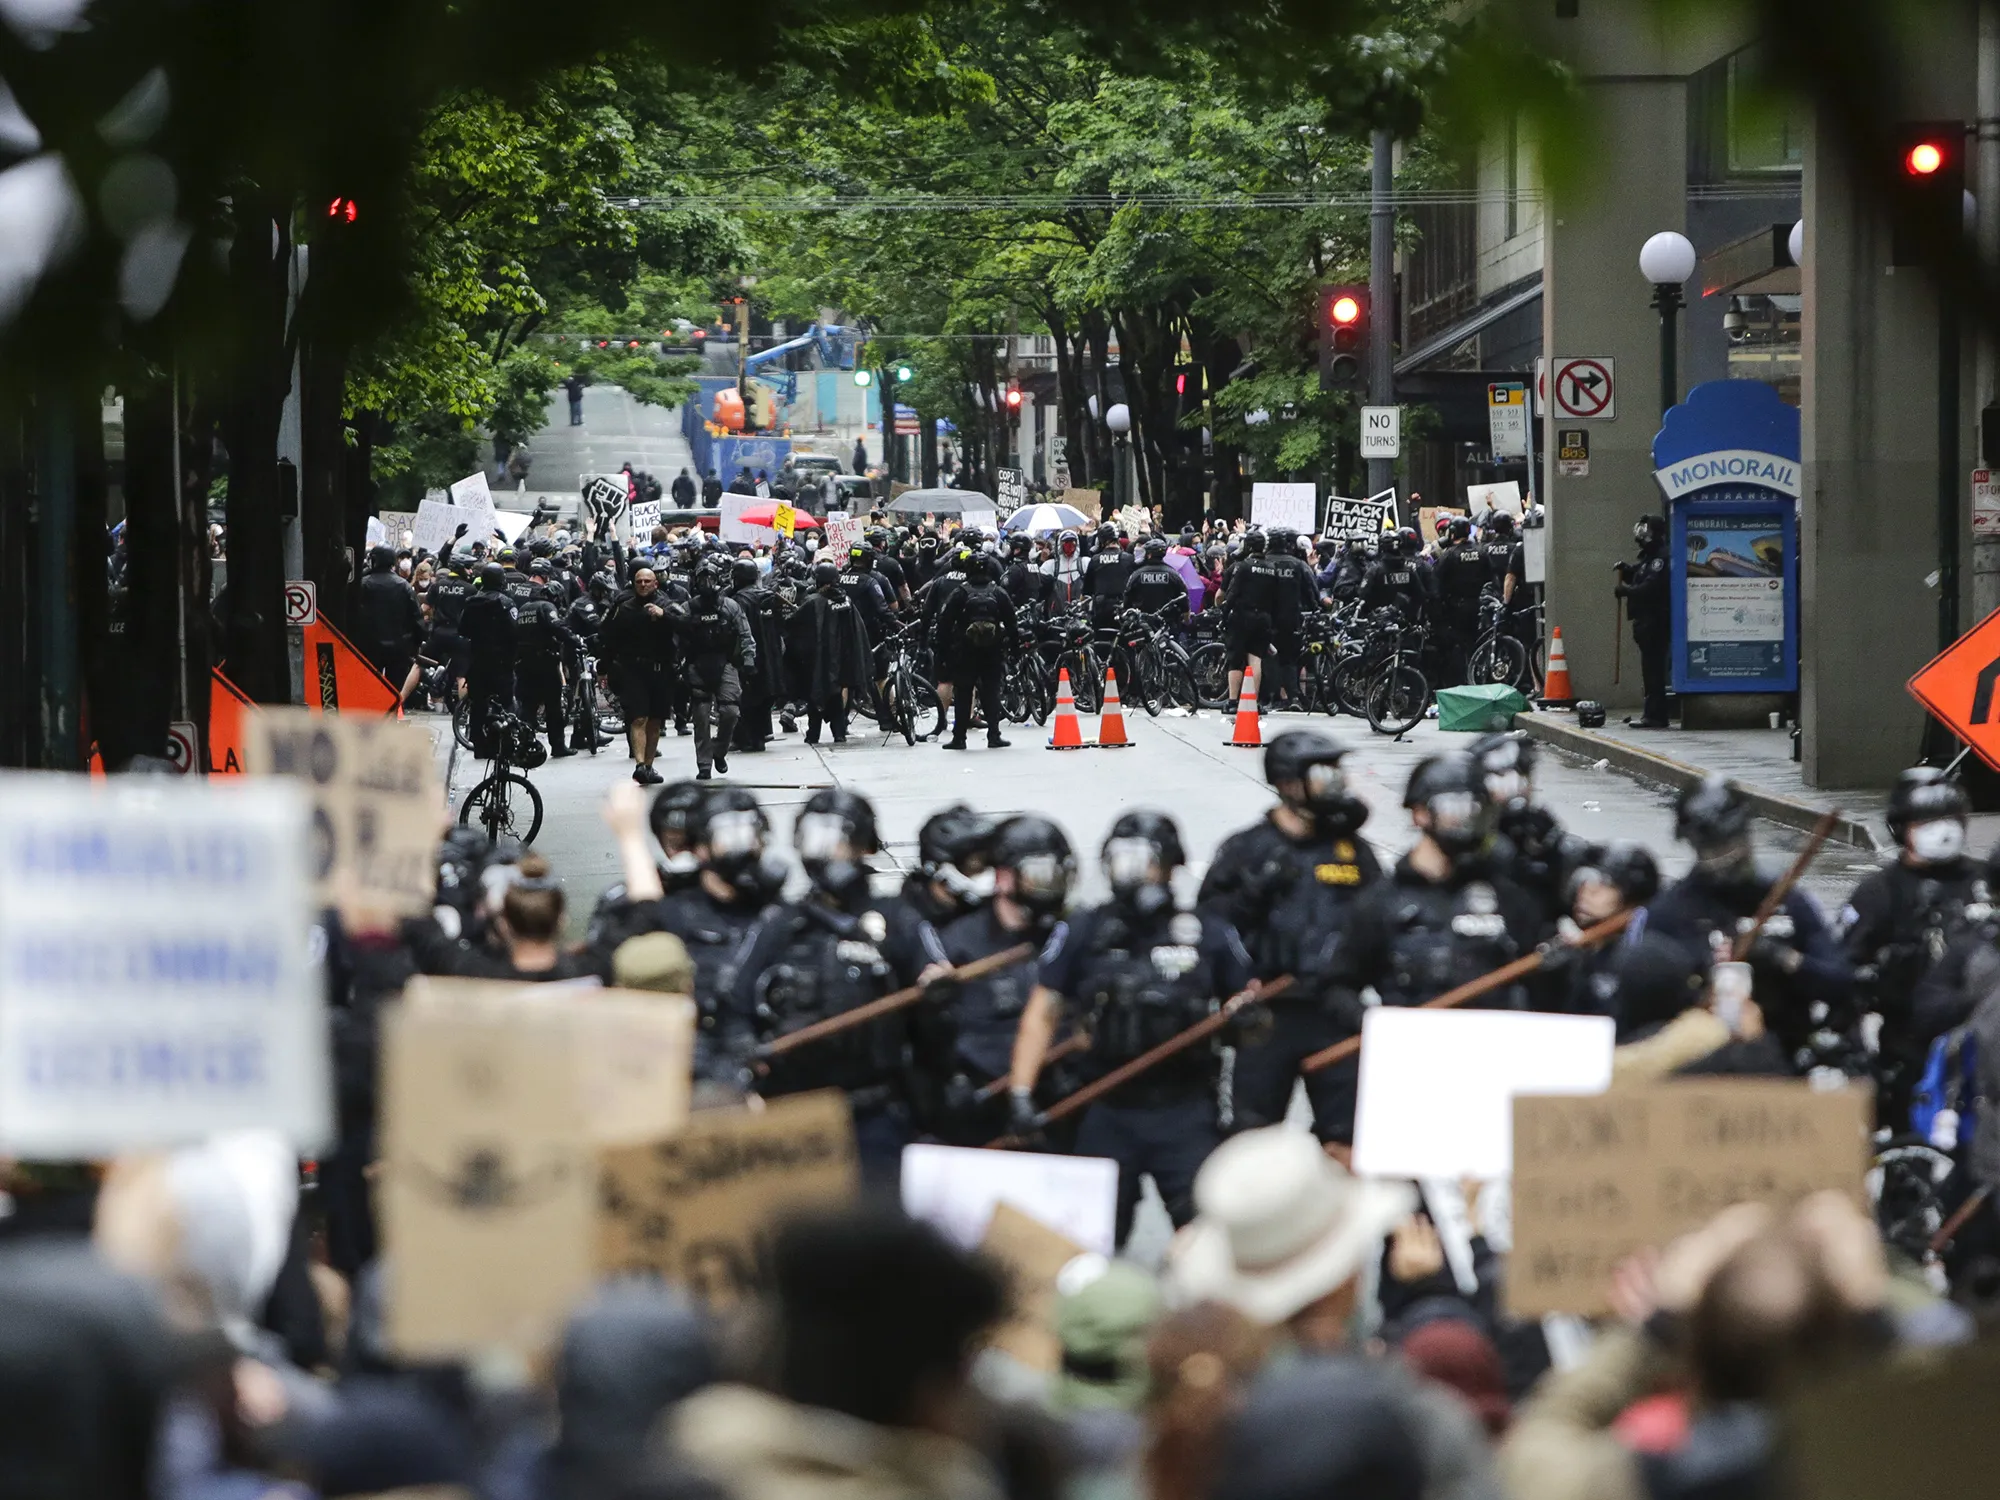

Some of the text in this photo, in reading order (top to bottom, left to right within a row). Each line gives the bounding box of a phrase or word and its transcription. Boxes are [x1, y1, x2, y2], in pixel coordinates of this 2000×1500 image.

[1370, 414, 1390, 428] NO
[1365, 435, 1395, 447] TURNS
[1561, 447, 1586, 458] BUS
[998, 470, 1014, 483] COPS
[1670, 457, 1794, 488] MONORAIL
[1975, 472, 1987, 480] NO
[998, 482, 1021, 498] ARE NOT
[1271, 485, 1295, 499] NO
[1691, 491, 1778, 500] ENTRANCE
[998, 494, 1019, 508] ABOVE
[1254, 497, 1314, 514] JUSTICE
[634, 502, 660, 517] BLACK
[1330, 500, 1382, 519] BLACK
[387, 513, 416, 528] SAY
[635, 515, 661, 528] LIVES
[826, 520, 857, 533] POLICE
[1332, 513, 1378, 532] LIVES
[829, 533, 845, 543] ARE
[1460, 551, 1480, 562] POLICE
[1488, 545, 1508, 555] POLICE
[839, 575, 859, 585] POLICE
[1142, 573, 1166, 582] POLICE
[701, 613, 718, 621] POLICE
